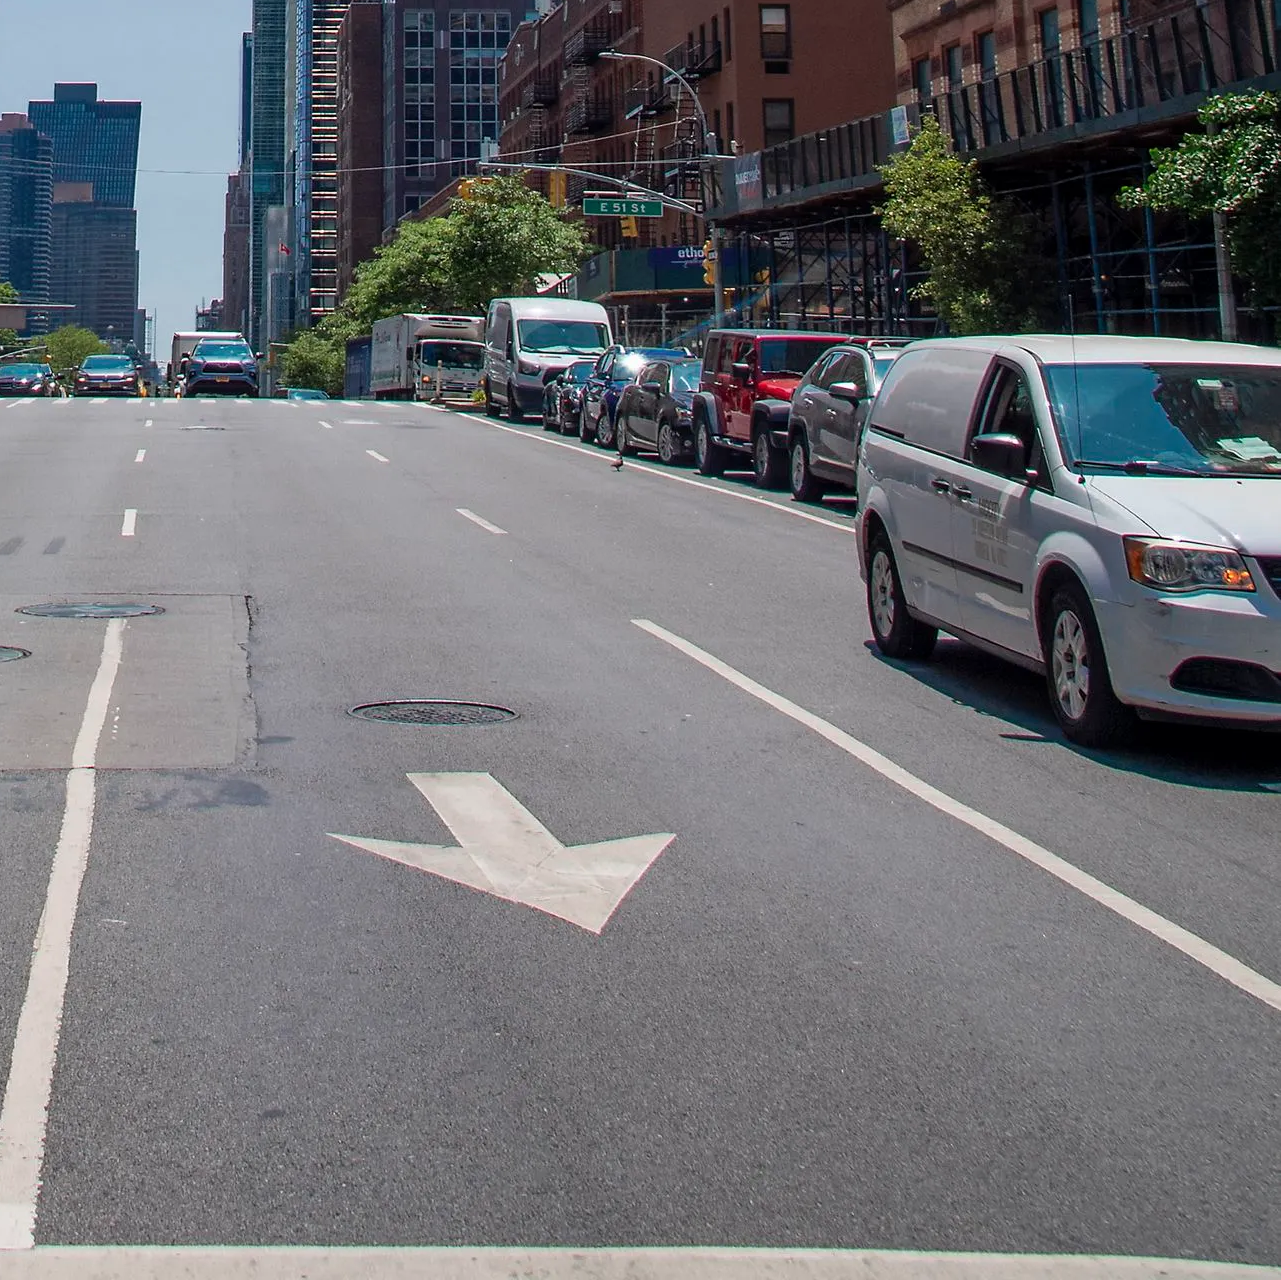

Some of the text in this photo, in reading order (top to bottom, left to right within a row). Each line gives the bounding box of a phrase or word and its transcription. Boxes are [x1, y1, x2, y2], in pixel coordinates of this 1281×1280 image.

[600, 203, 646, 213] E 51 St
[678, 247, 705, 259] etho
